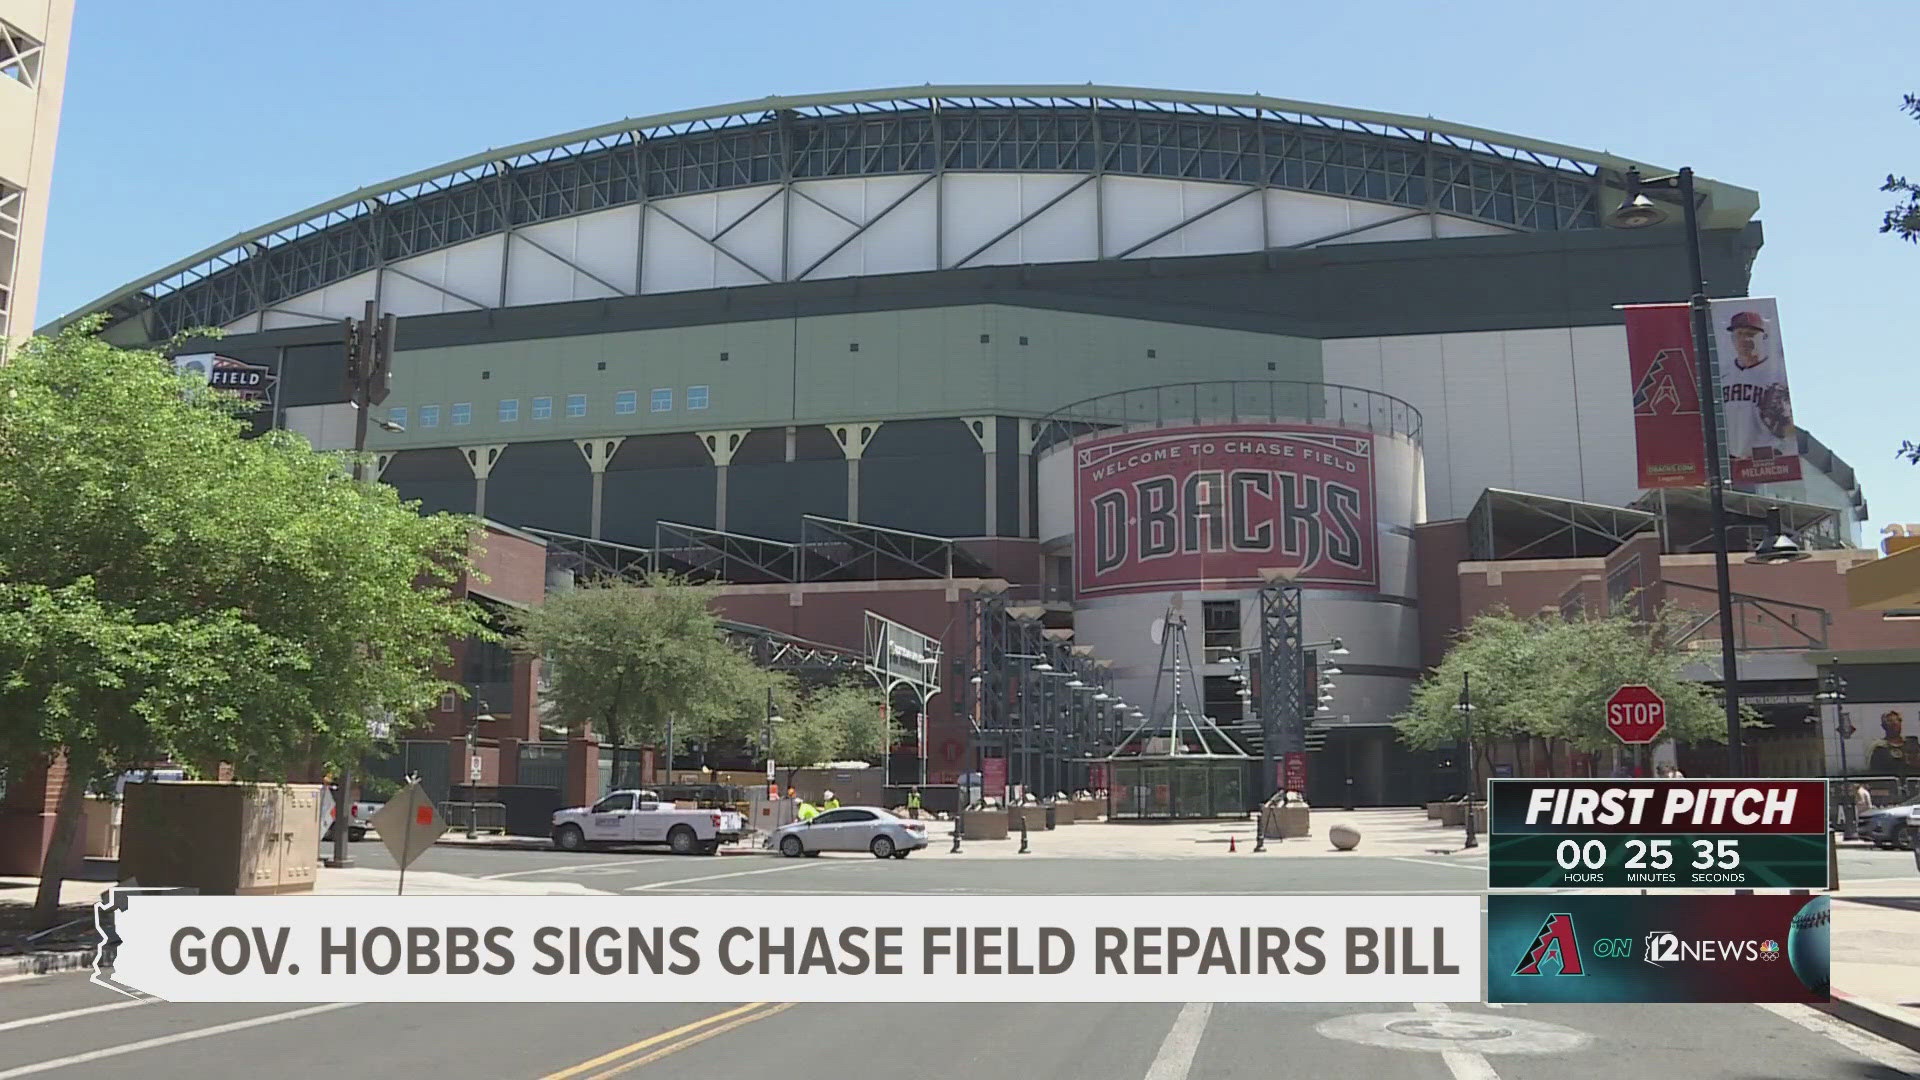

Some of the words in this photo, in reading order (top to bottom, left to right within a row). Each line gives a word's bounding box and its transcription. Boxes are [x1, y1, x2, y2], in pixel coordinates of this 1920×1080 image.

[212, 371, 260, 385] FIELD
[1093, 446, 1181, 482] WELCOME
[1189, 443, 1215, 455] TO
[1224, 442, 1295, 457] CHASE
[1303, 448, 1356, 473] FIELD
[1611, 703, 1661, 725] STOP
